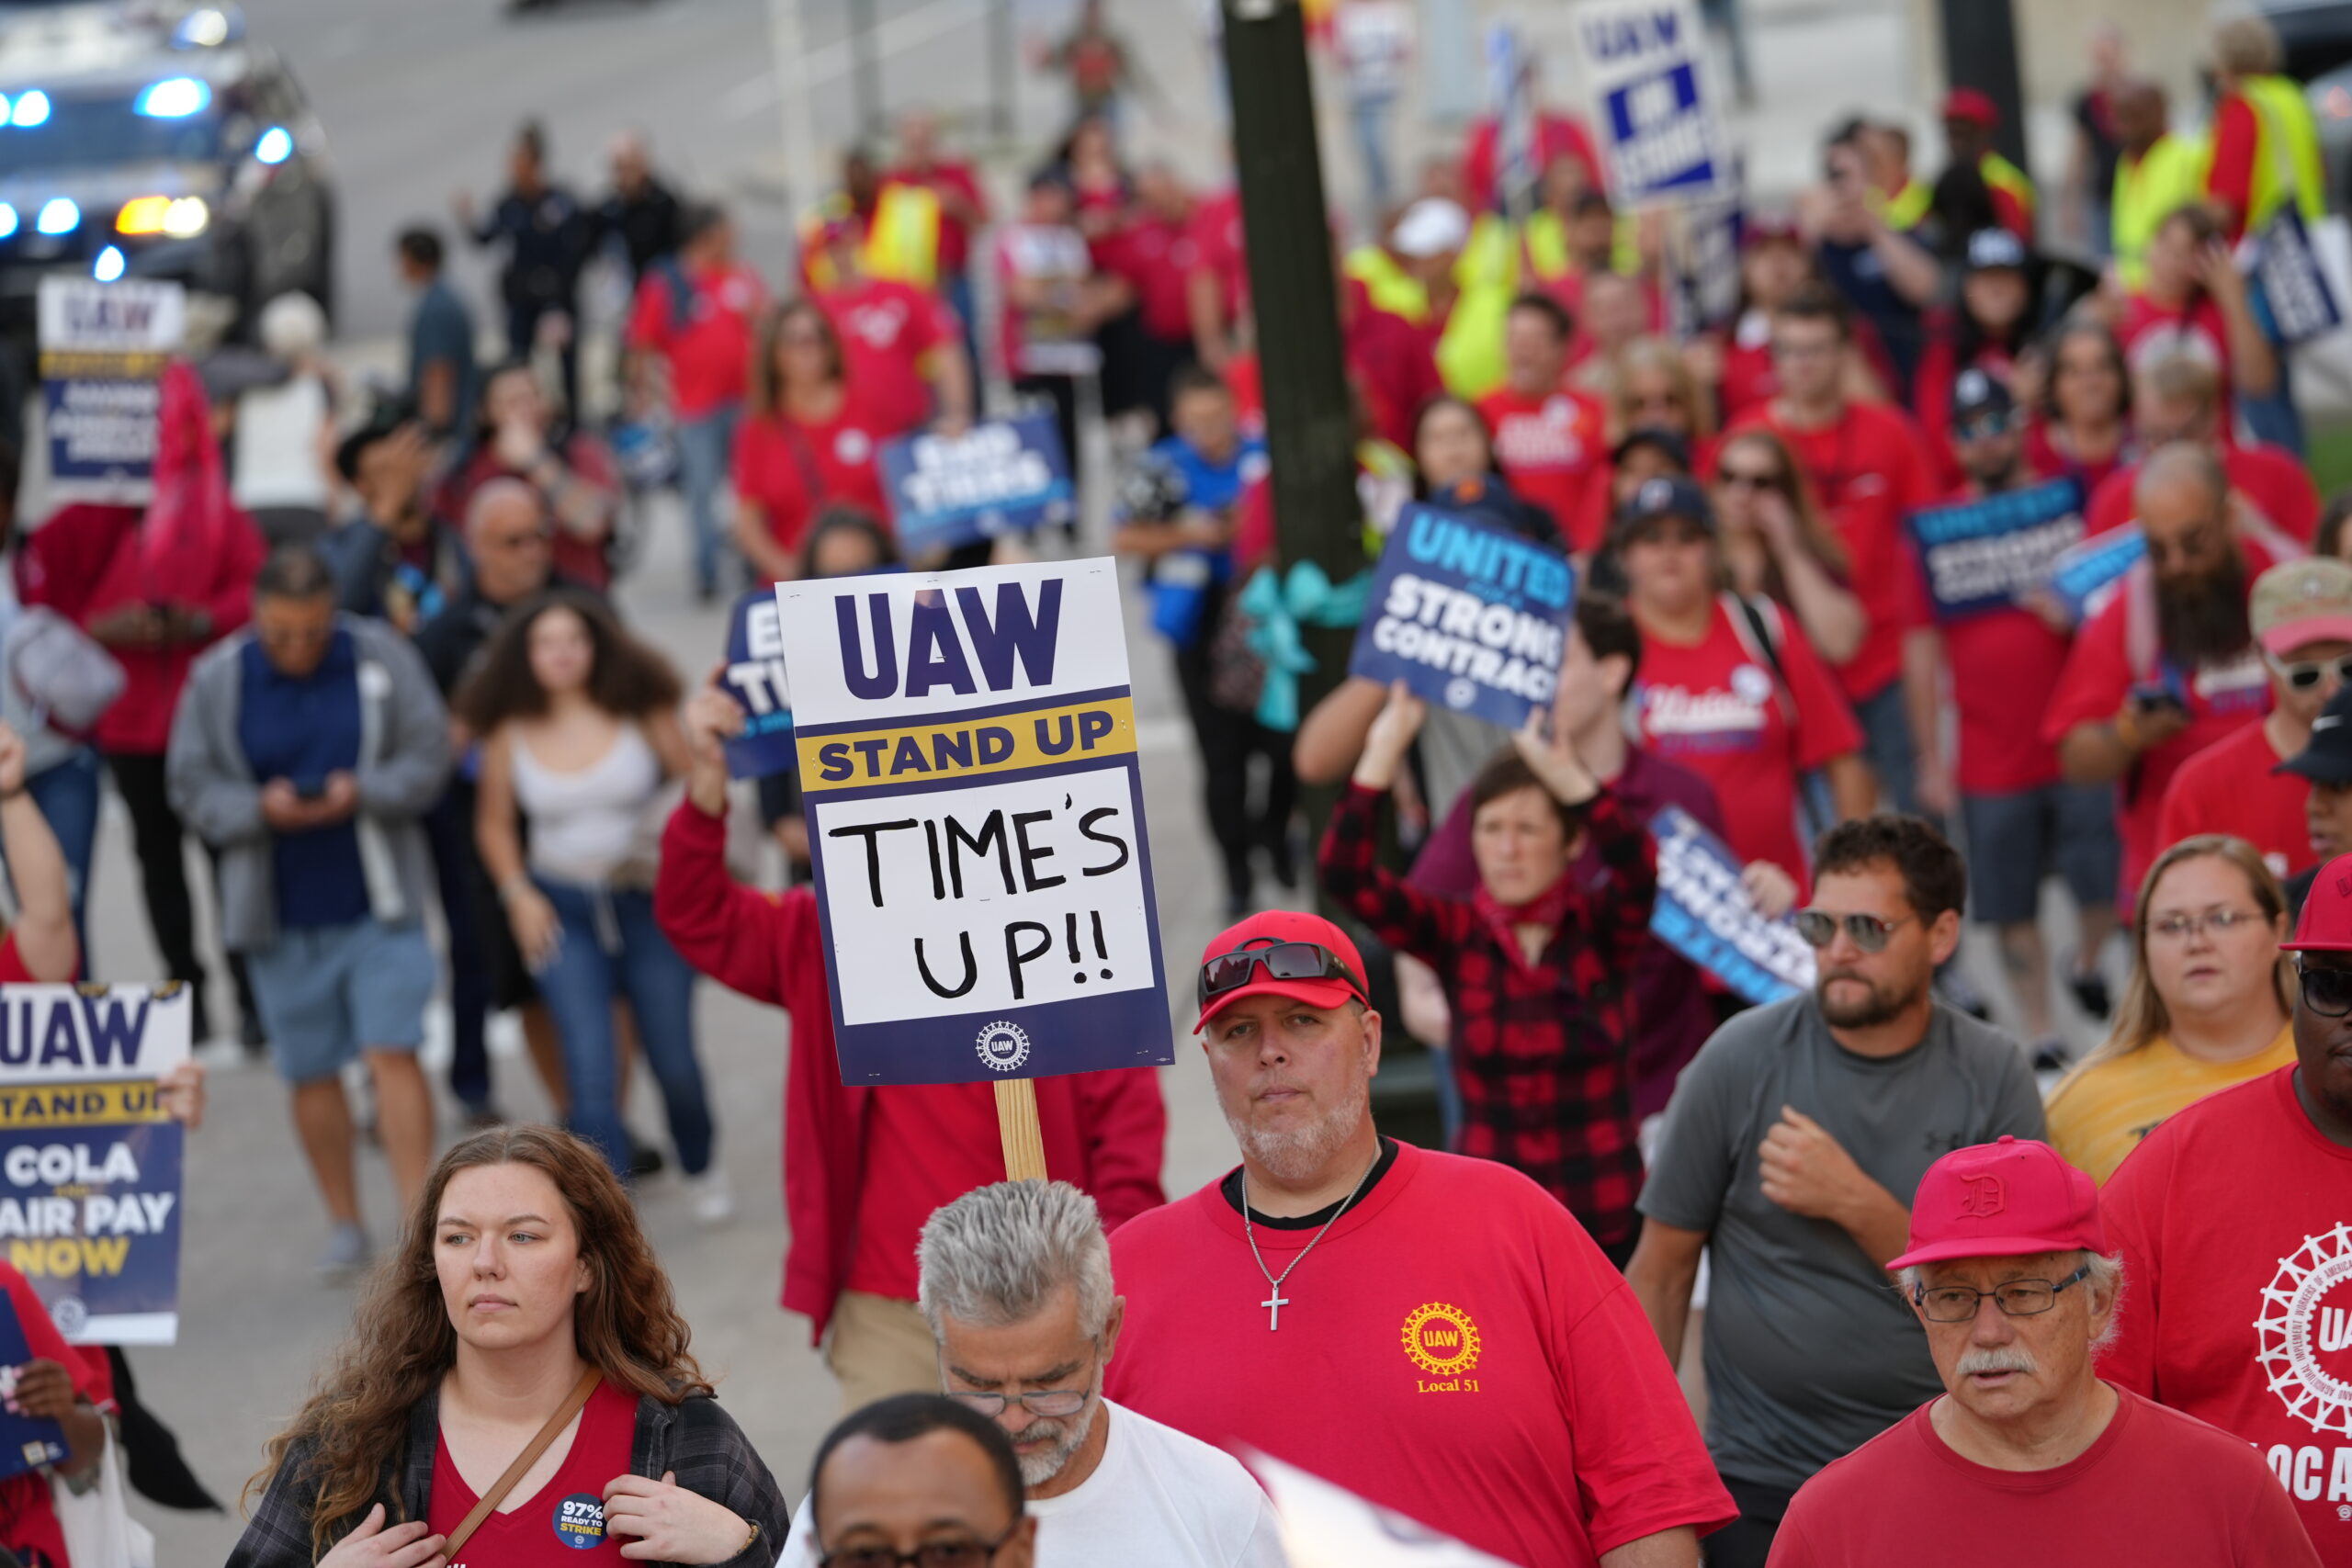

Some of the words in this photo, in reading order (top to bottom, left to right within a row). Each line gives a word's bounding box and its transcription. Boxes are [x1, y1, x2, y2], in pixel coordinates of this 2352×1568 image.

[834, 579, 1063, 700] UAW
[1373, 614, 1557, 703] CONTRAC
[819, 732, 1015, 782] STAND
[1035, 710, 1114, 756] UP
[829, 793, 1129, 908] TIME'S
[914, 910, 1114, 999] UP!!
[0, 995, 151, 1066] UAW
[991, 1040, 1013, 1052] UAW
[0, 1093, 106, 1118] TAND
[5, 1144, 139, 1187] COLA
[0, 1197, 75, 1240] AIR
[84, 1192, 175, 1235] PAY
[10, 1236, 130, 1278] NOW
[2295, 1284, 2316, 1316] WORKERS
[1423, 1330, 1459, 1348] UAW
[2292, 1320, 2305, 1362] IMPLEMENT
[1417, 1379, 1460, 1393] Local
[1464, 1380, 1480, 1392] 51
[2250, 1442, 2352, 1502] OCA
[560, 1516, 589, 1525] READY
[560, 1523, 602, 1536] STRIKE
[563, 1501, 603, 1519] 97%
